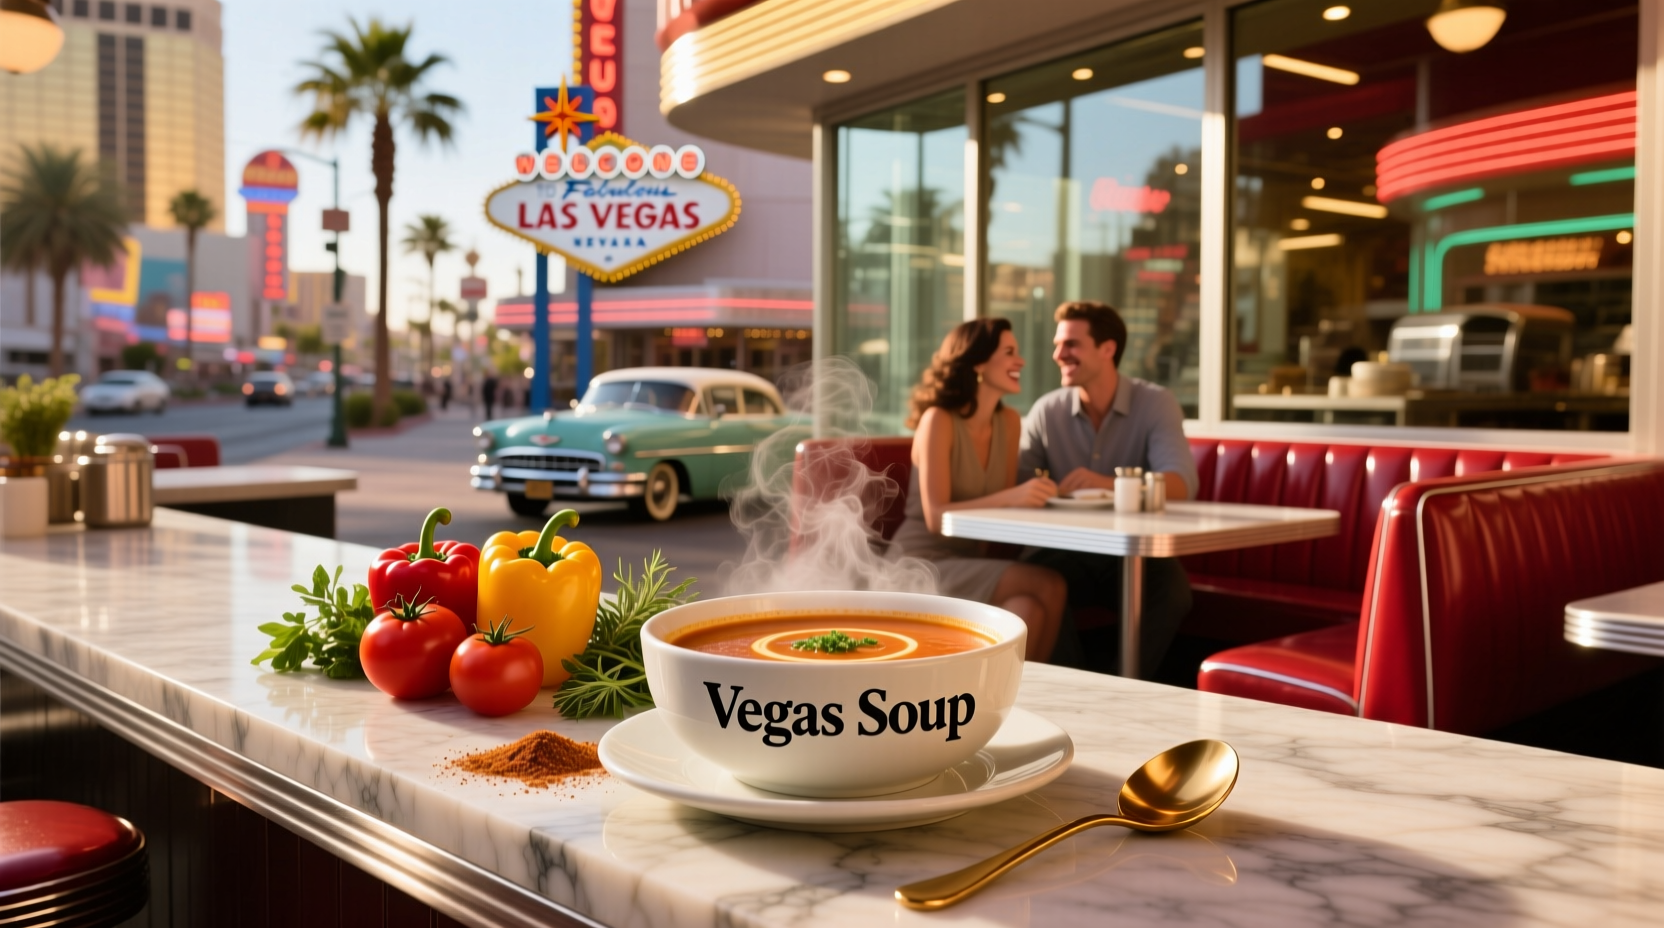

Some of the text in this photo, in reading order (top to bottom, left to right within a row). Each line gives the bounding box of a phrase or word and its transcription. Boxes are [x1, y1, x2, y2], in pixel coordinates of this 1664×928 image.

[518, 202, 700, 230] LAS VEGAS
[702, 681, 976, 748] Vegas Soup
